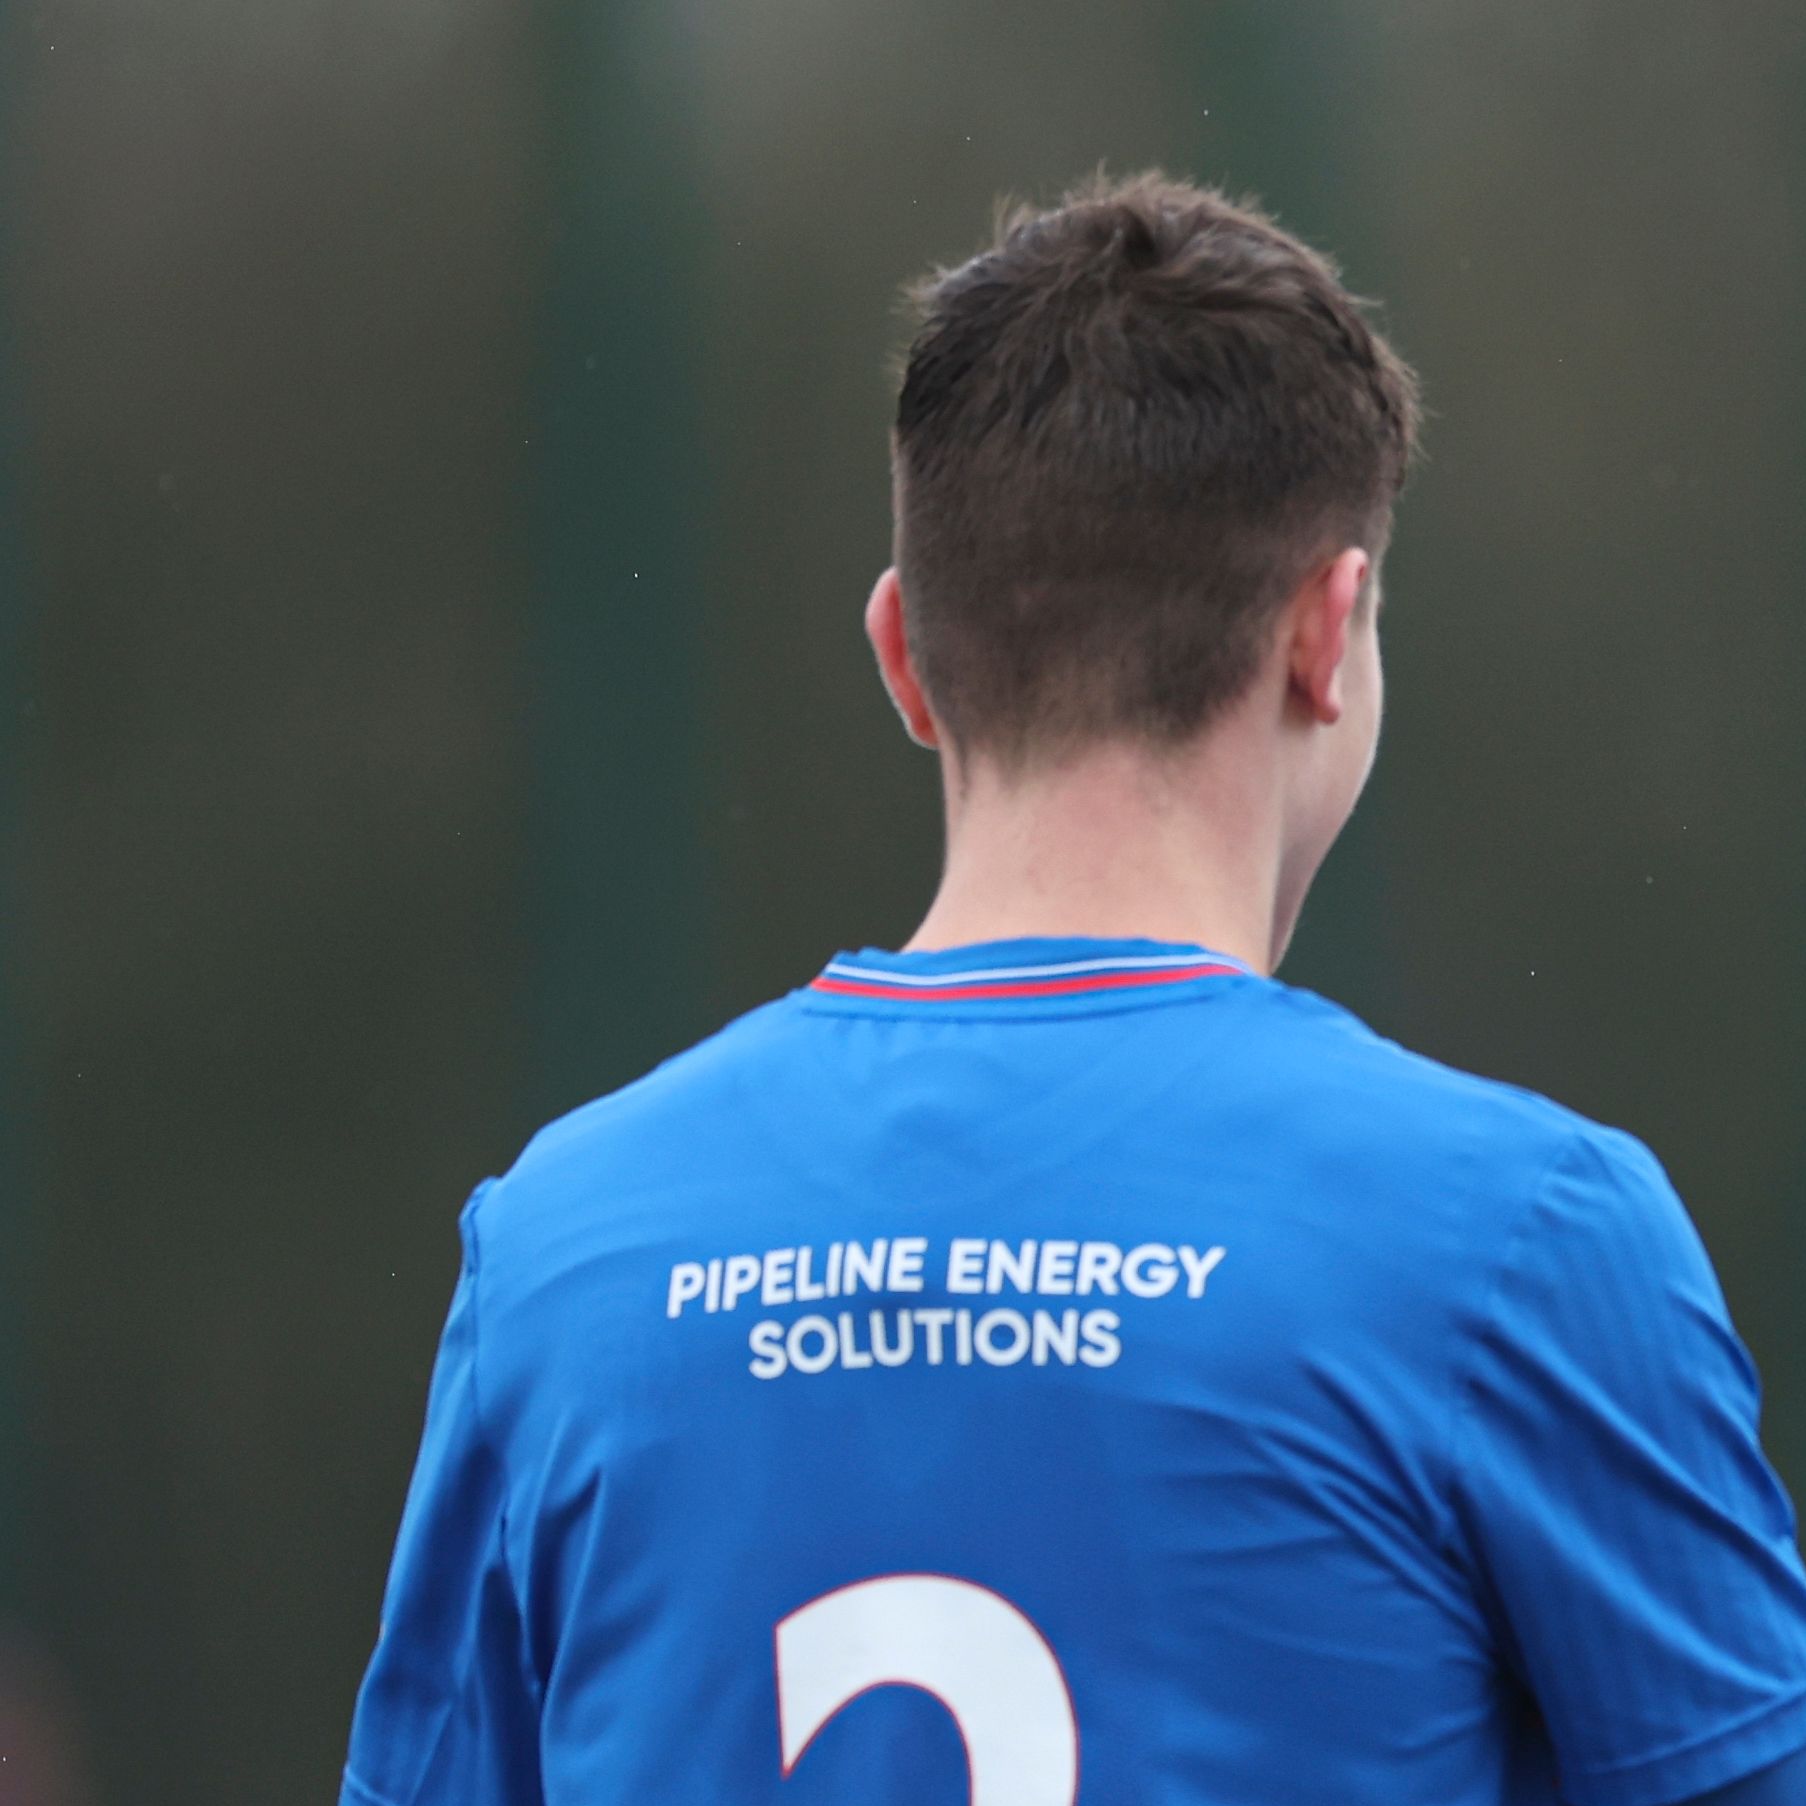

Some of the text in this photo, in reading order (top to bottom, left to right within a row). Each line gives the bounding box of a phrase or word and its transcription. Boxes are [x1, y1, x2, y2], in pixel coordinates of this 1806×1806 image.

[667, 1237, 1227, 1319] PIPELINE ENERGY
[748, 1307, 1122, 1380] SOLUTIONS
